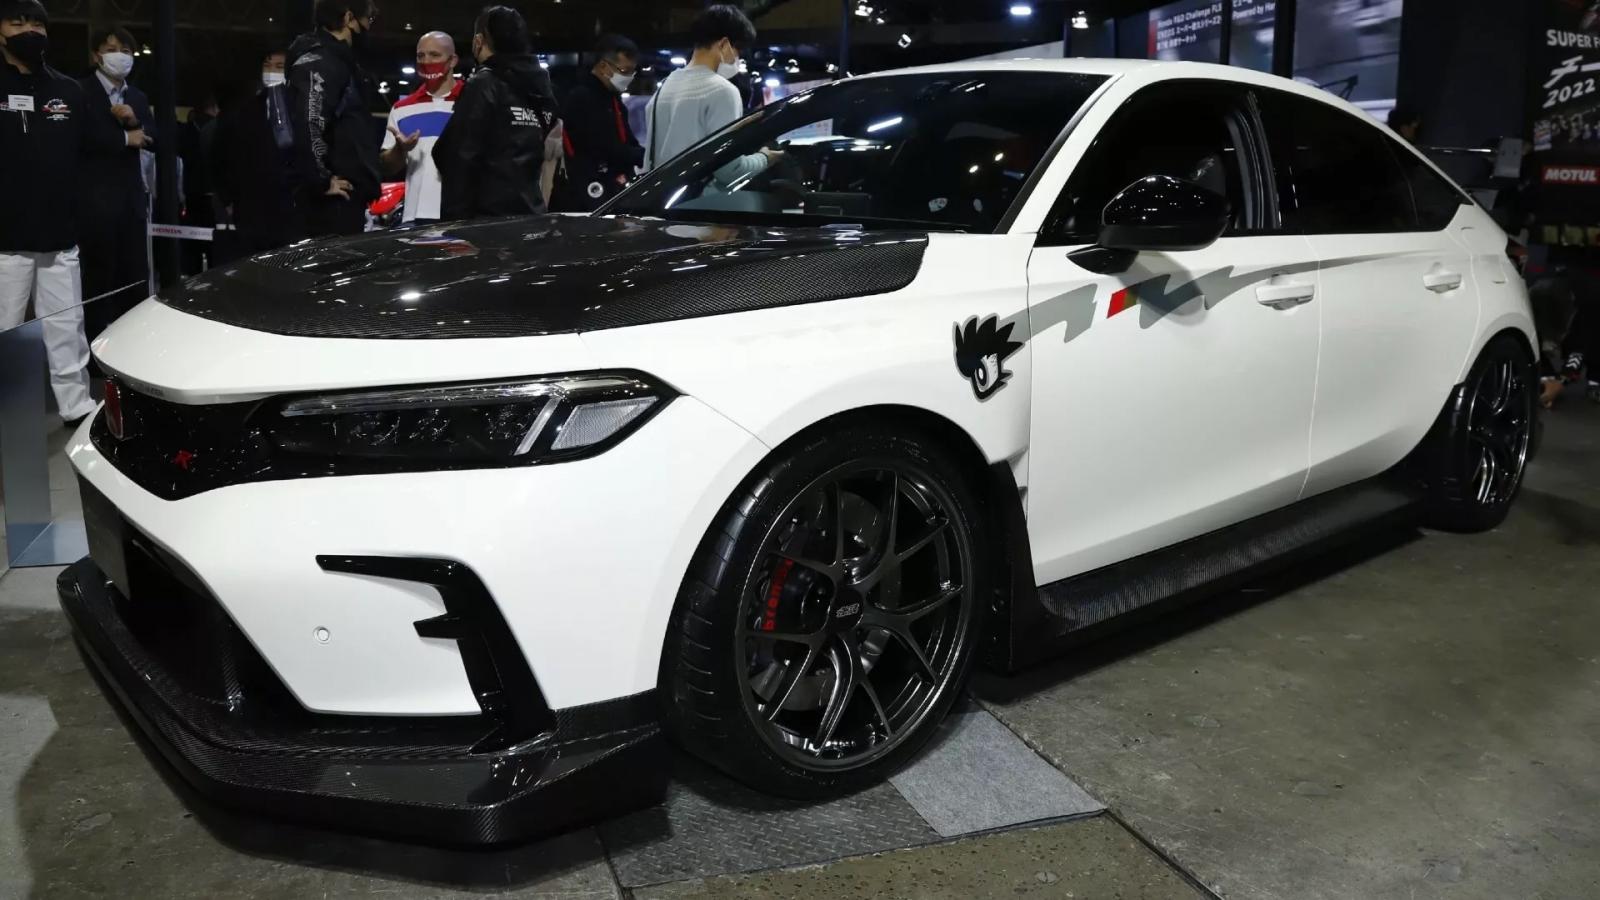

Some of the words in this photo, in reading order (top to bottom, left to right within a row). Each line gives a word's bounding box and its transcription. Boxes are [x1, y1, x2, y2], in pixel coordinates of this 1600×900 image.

[1185, 7, 1211, 21] Challenge
[1232, 6, 1256, 20] Powered
[1256, 5, 1264, 16] by
[1547, 29, 1592, 48] SUPER
[1542, 78, 1596, 108] 2022
[1544, 169, 1597, 181] MOTUL
